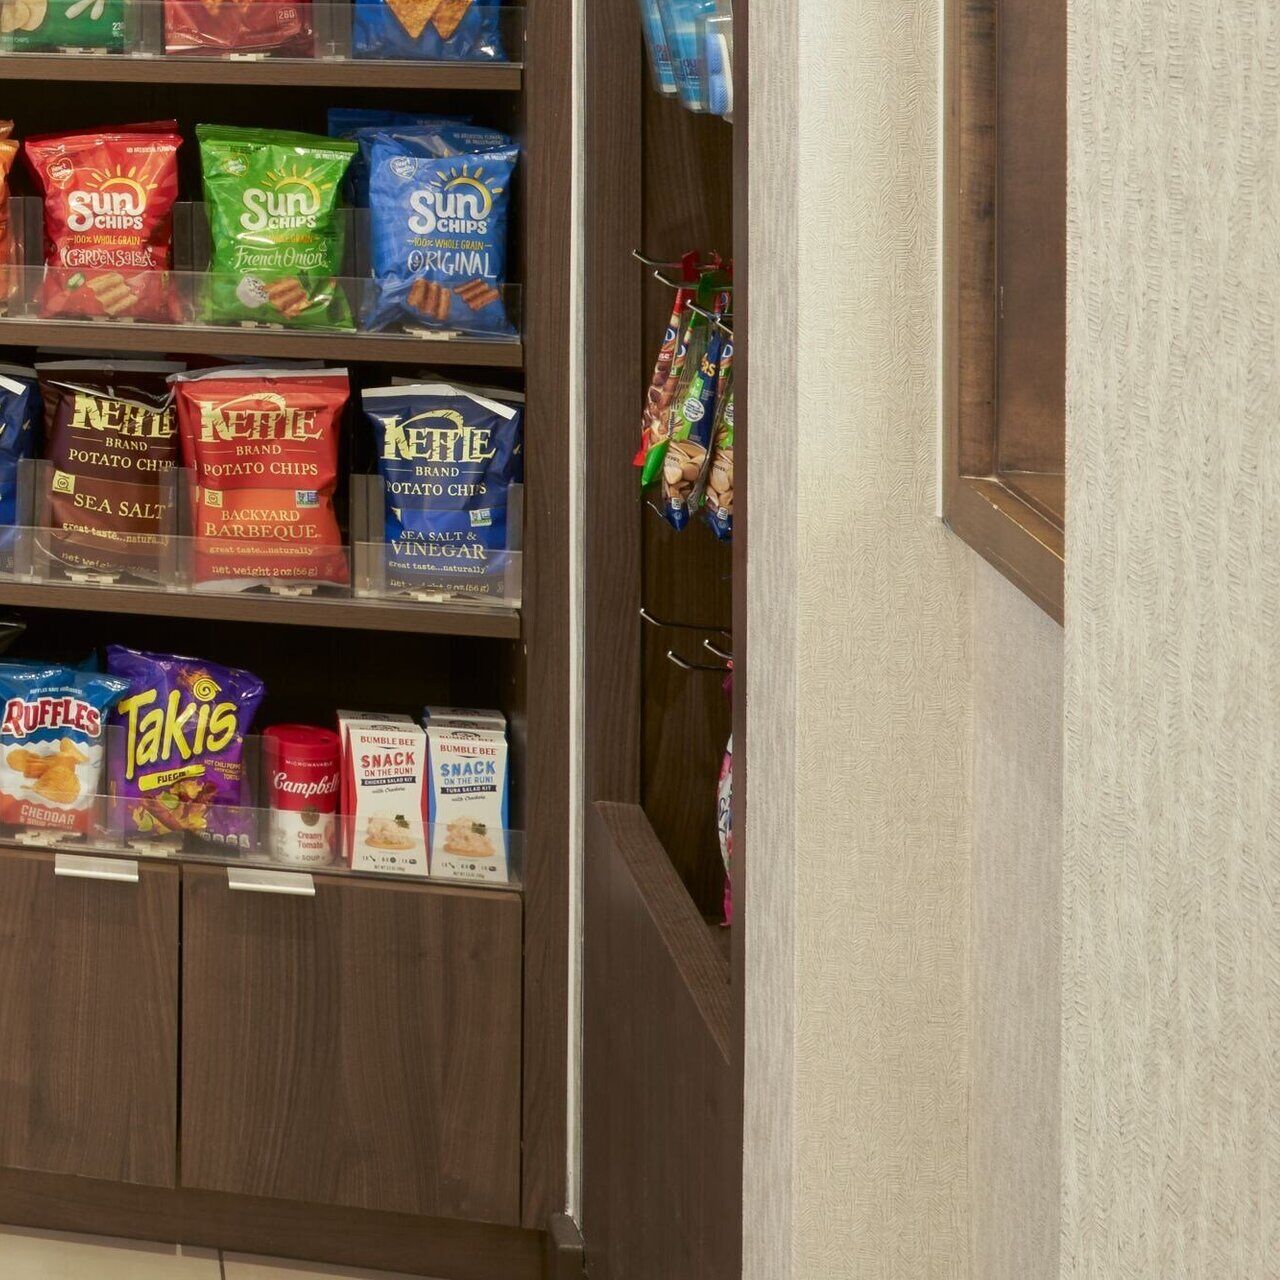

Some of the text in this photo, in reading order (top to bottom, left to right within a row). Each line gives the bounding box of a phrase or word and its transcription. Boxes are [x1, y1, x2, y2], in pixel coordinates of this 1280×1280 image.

[67, 190, 147, 232] Sun
[240, 188, 321, 231] Sun
[408, 188, 493, 235] Sun
[95, 216, 144, 231] CHIPS
[268, 215, 317, 230] CHIPS
[438, 220, 488, 234] CHIPS
[73, 234, 141, 245] 100% WHOLE GRAIN
[412, 238, 484, 250] 100% WHOLE GRAIN
[234, 244, 325, 269] French Onion
[407, 249, 497, 278] ORIGINAL
[198, 392, 324, 443] KETTLE
[380, 409, 497, 463] KETTLE
[105, 437, 148, 452] BRAND
[236, 444, 282, 456] BRAND
[68, 448, 132, 469] POTATO
[203, 460, 319, 476] POTATO CHIPS
[415, 466, 460, 478] BRAND
[386, 482, 488, 497] POTATO CHIPS
[73, 493, 167, 520] SEA SALT
[222, 509, 301, 522] BACKYARD
[204, 523, 319, 542] BARBEQUE
[400, 531, 477, 542] SEA SALT &
[391, 539, 487, 560] VINEGAR
[211, 564, 271, 578] net weight
[2, 697, 101, 738] RUFFLES
[118, 678, 238, 780] Takis
[360, 735, 416, 747] BUMBLE BEE
[440, 744, 497, 756] BUMBLE BEE
[360, 751, 416, 769] SNACK
[364, 767, 414, 777] ON THE RUN!
[440, 760, 497, 777] SNACK
[363, 778, 387, 786] CHICKEN
[444, 776, 494, 786] ON THE RUN!
[446, 785, 482, 794] TUNA SALAD
[20, 804, 76, 826] CHEDDAR
[297, 830, 323, 841] Creamy
[297, 840, 324, 850] Tomato
[301, 854, 321, 862] SOUP
